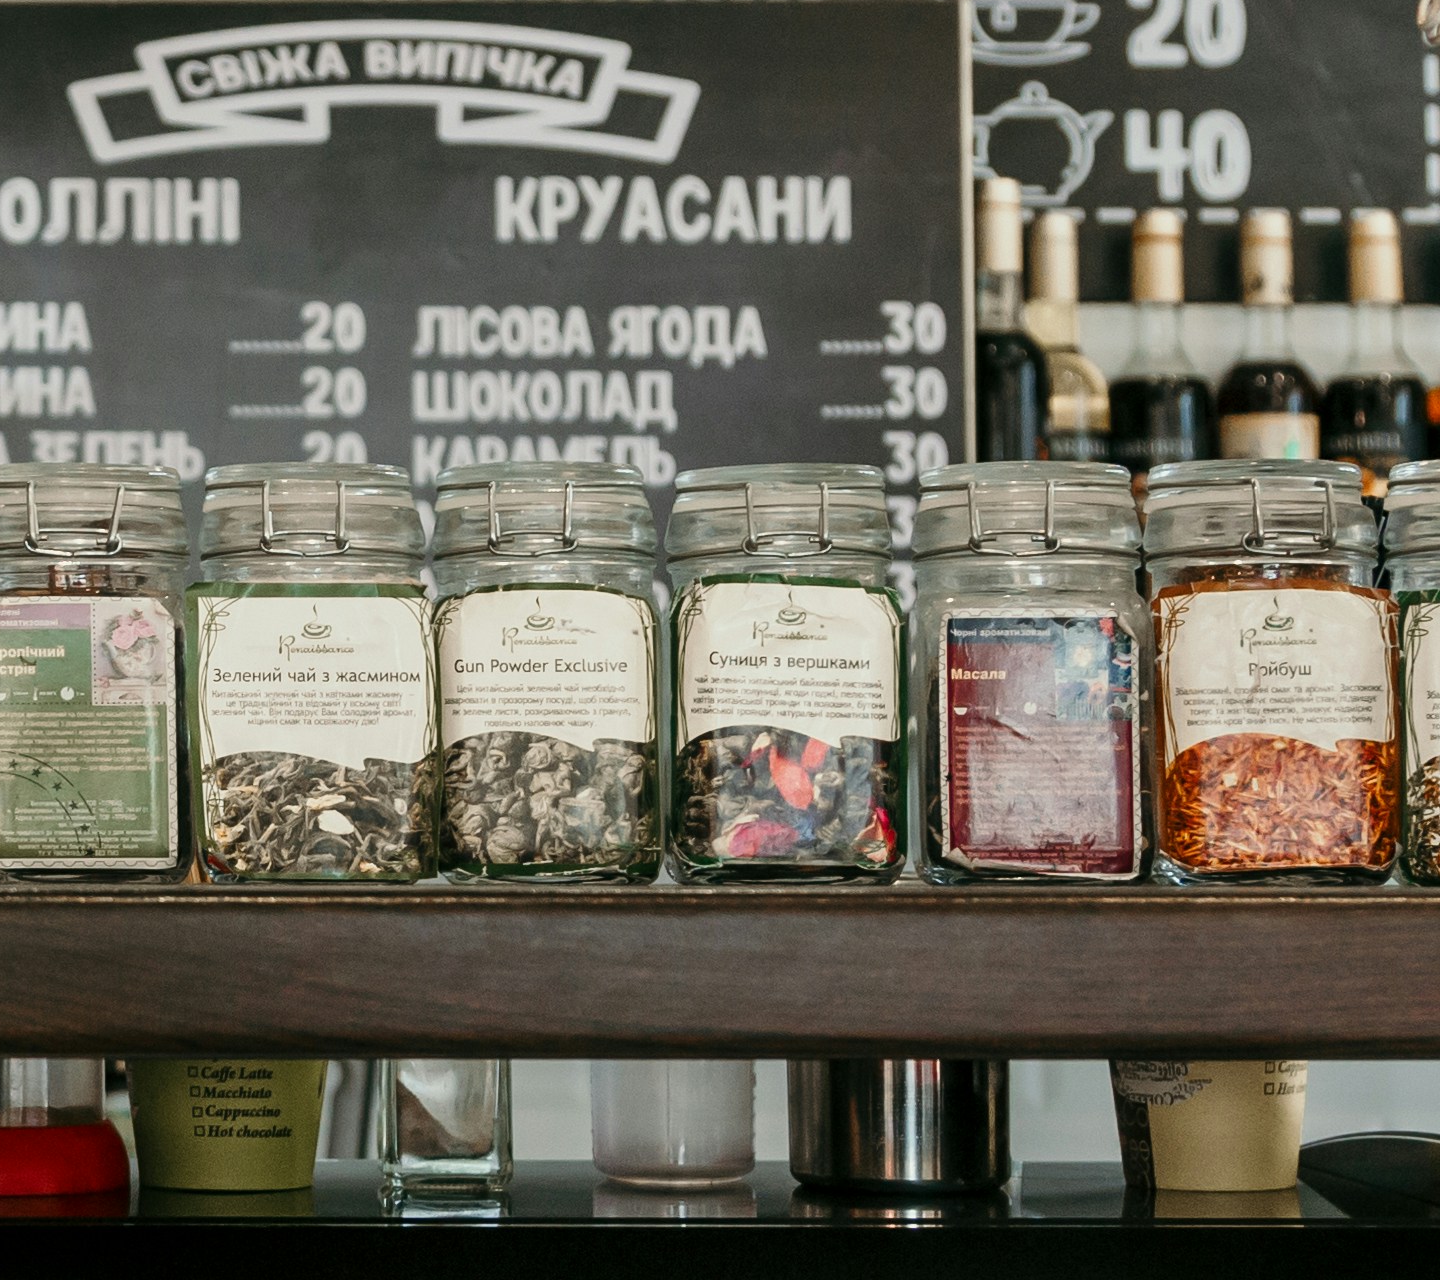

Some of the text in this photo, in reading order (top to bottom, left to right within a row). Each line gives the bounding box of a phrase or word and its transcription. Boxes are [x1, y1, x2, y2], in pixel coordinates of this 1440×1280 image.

[178, 40, 587, 101] СВІЖА ВИПІЧКА
[1123, 109, 1253, 205] 40
[495, 174, 853, 246] КРУАСАНИ
[302, 300, 367, 355] 20
[412, 300, 947, 366] ЛІСОВА ЯГОДА 30
[302, 366, 367, 420] 20
[412, 366, 948, 431] ШОКОЛАД 30
[212, 667, 421, 683] Зелений чай з жасмином
[454, 658, 628, 673] Gun Powder Exclusive
[709, 651, 871, 671] Суниця з вершками
[951, 668, 1007, 680] Масала
[201, 1086, 272, 1099] Macchiato
[205, 1104, 281, 1121] Cappuccino
[207, 1125, 292, 1138] Hot chocolate
